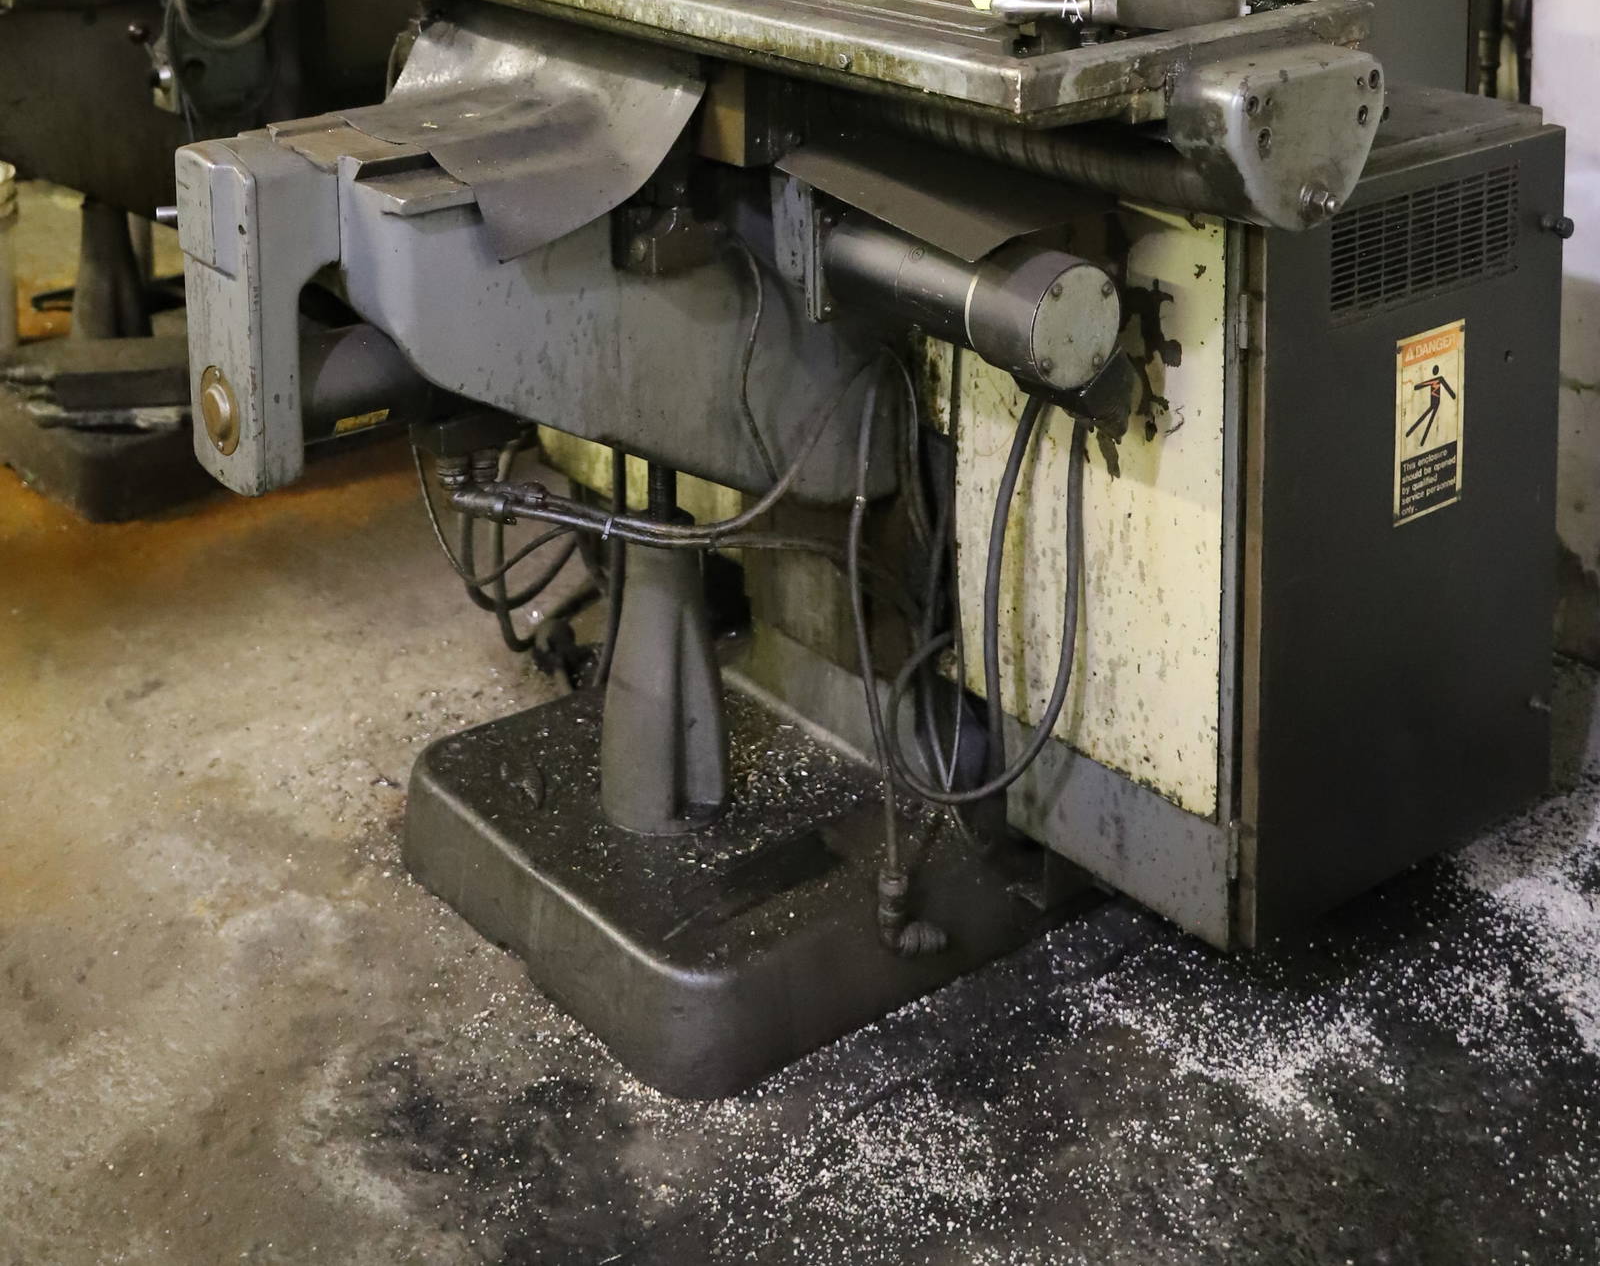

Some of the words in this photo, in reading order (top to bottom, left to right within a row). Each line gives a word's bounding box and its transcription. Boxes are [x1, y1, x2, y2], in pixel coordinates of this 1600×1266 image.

[1415, 334, 1457, 359] DANGER
[1402, 461, 1417, 473] This
[1416, 449, 1448, 468] enclosure
[1401, 468, 1423, 485] should
[1423, 466, 1433, 476] be
[1401, 486, 1411, 496] by
[1411, 472, 1438, 492] qualified
[1401, 490, 1425, 506] service
